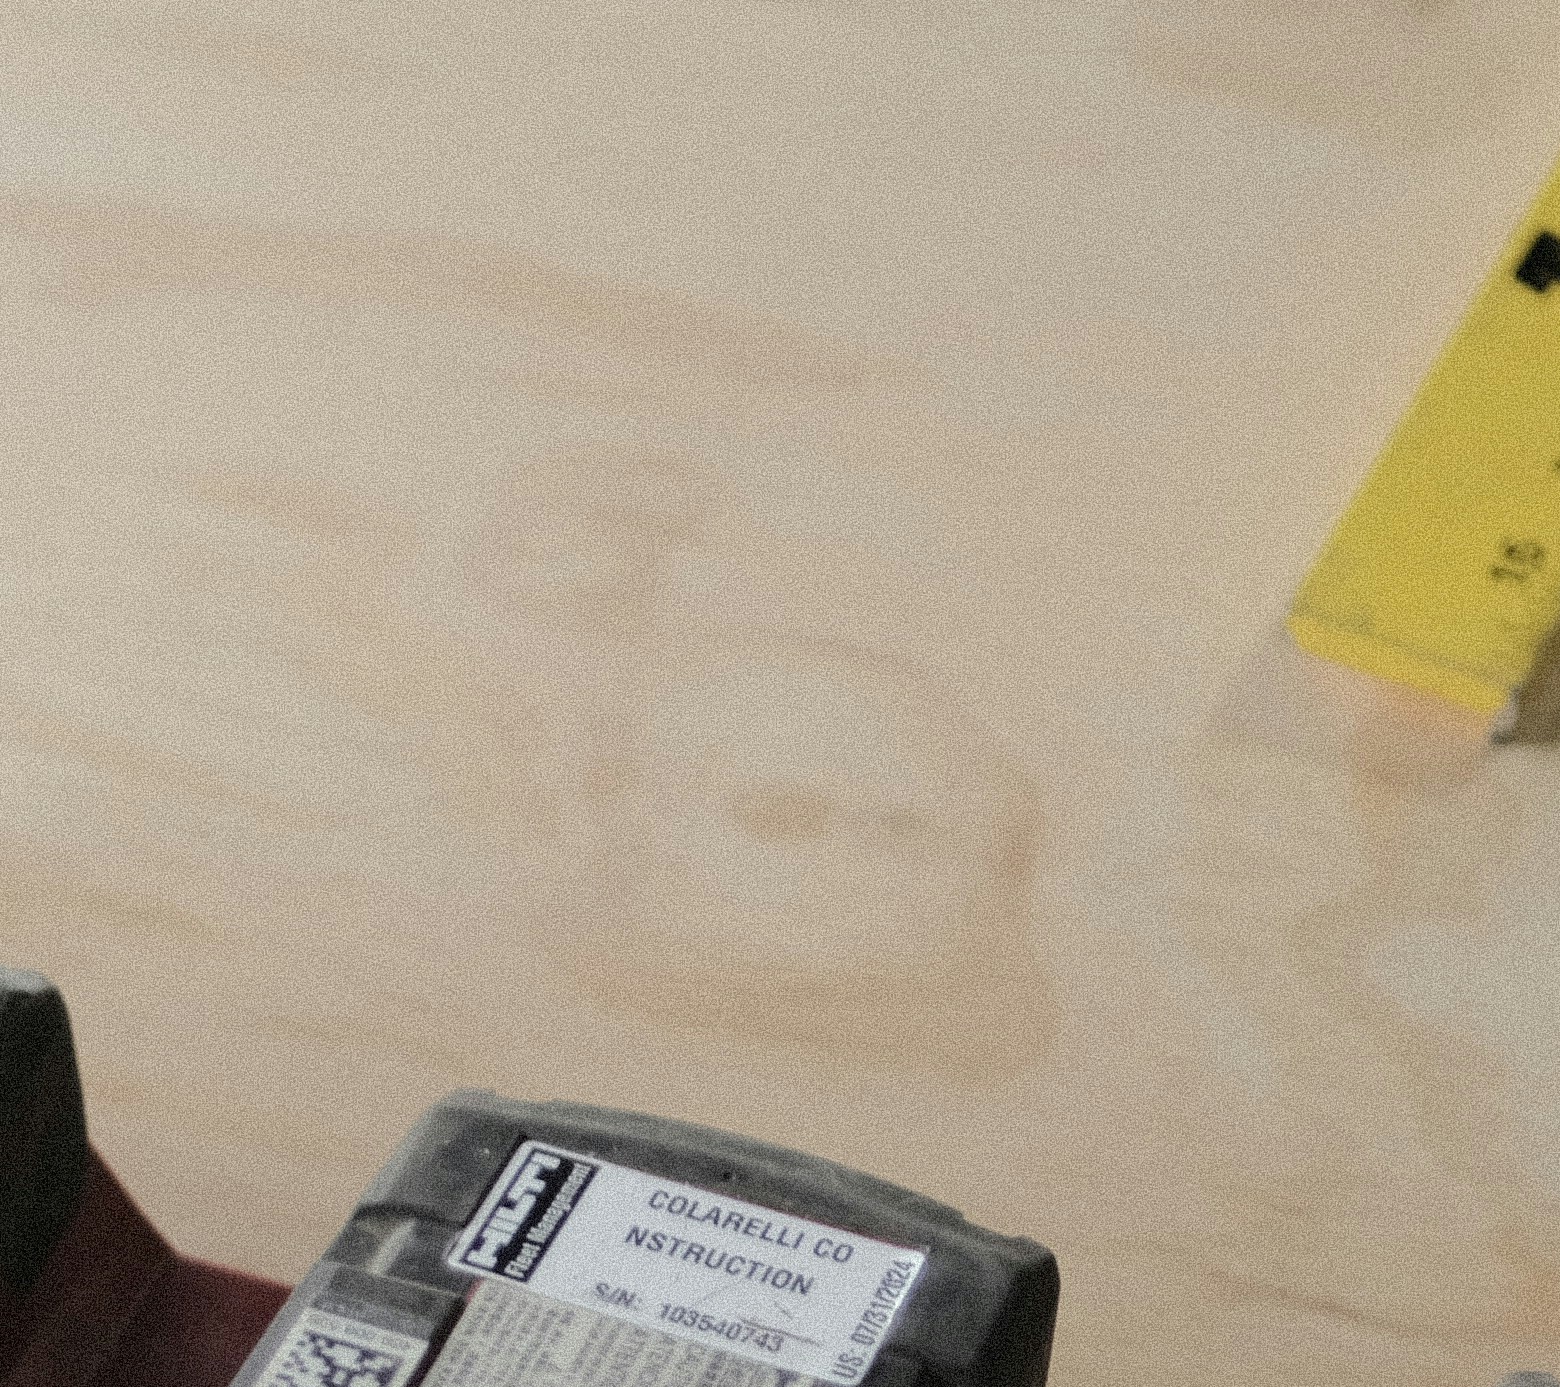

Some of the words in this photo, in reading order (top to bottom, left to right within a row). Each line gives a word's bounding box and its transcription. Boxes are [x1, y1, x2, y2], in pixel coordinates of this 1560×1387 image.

[466, 1151, 561, 1270] HILTI
[503, 1240, 543, 1279] Fleet
[523, 1160, 595, 1246] Management
[645, 1189, 807, 1250] COLARELLI
[809, 1236, 857, 1265] CO
[622, 1225, 817, 1296] NSTRUCTION
[588, 1283, 646, 1313] S/N:
[830, 1345, 869, 1381] US:
